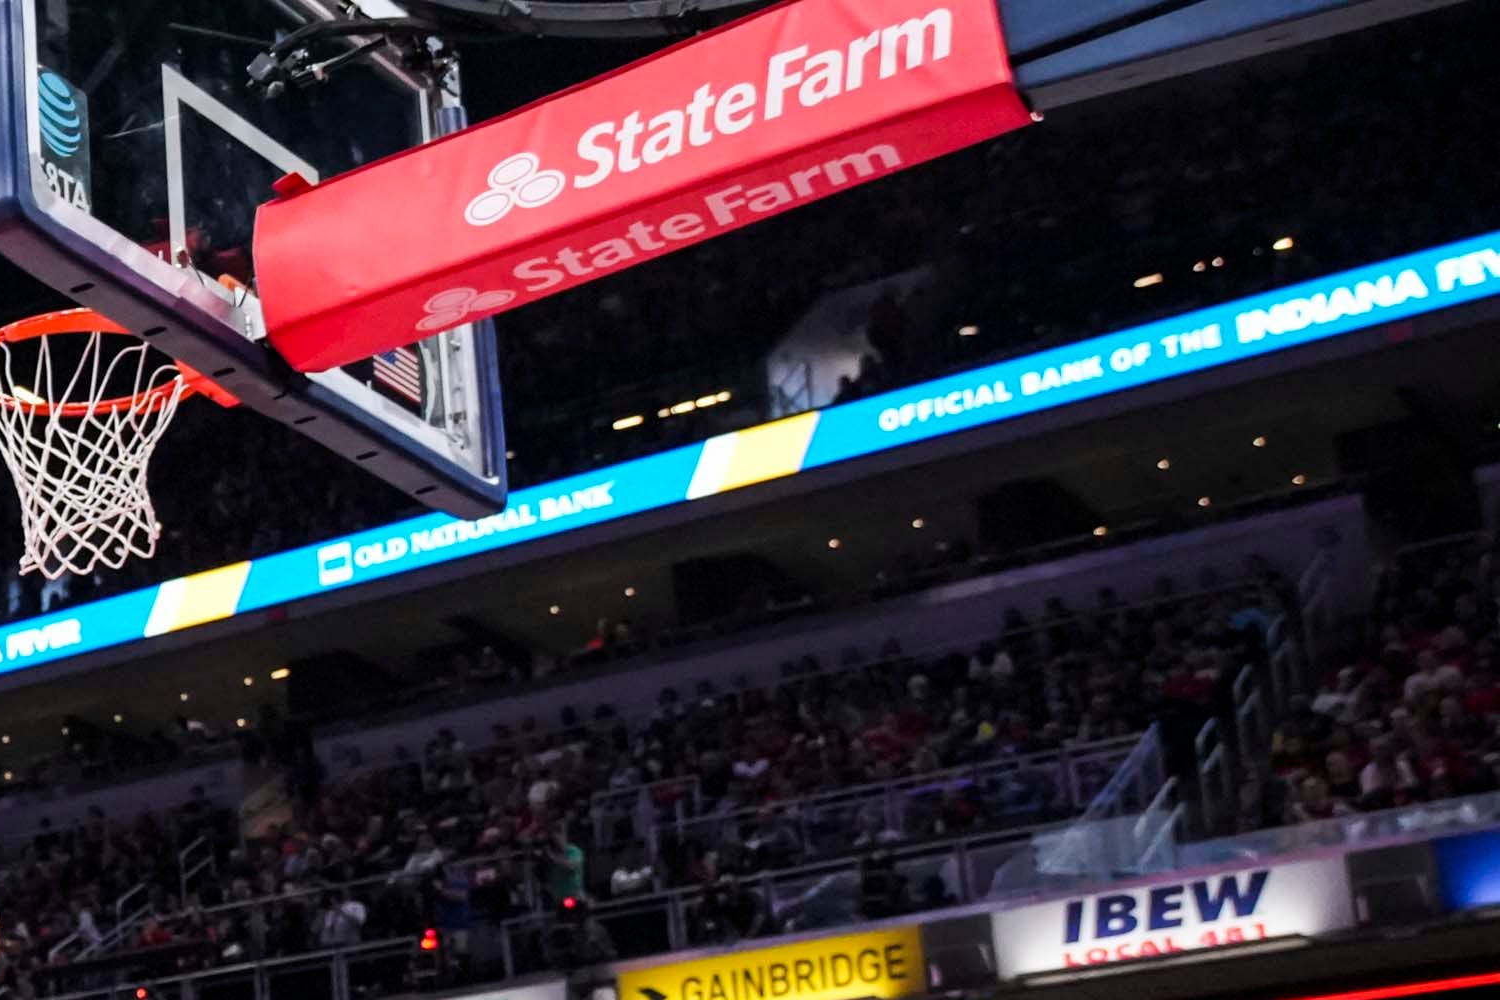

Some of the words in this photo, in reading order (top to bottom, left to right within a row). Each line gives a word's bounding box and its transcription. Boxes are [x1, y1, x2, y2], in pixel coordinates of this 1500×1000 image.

[878, 381, 1012, 431] OFFICIAL
[1020, 355, 1103, 396] BANK
[1110, 341, 1151, 373] OF
[1160, 324, 1222, 358] THE
[1236, 269, 1428, 343] INDIANA
[354, 537, 408, 568] OLD
[410, 504, 537, 554] NATIONAL
[538, 480, 615, 521] BANK
[6, 618, 82, 660] FEVER
[1064, 870, 1270, 944] IBEW
[1063, 936, 1182, 968] LOCAL
